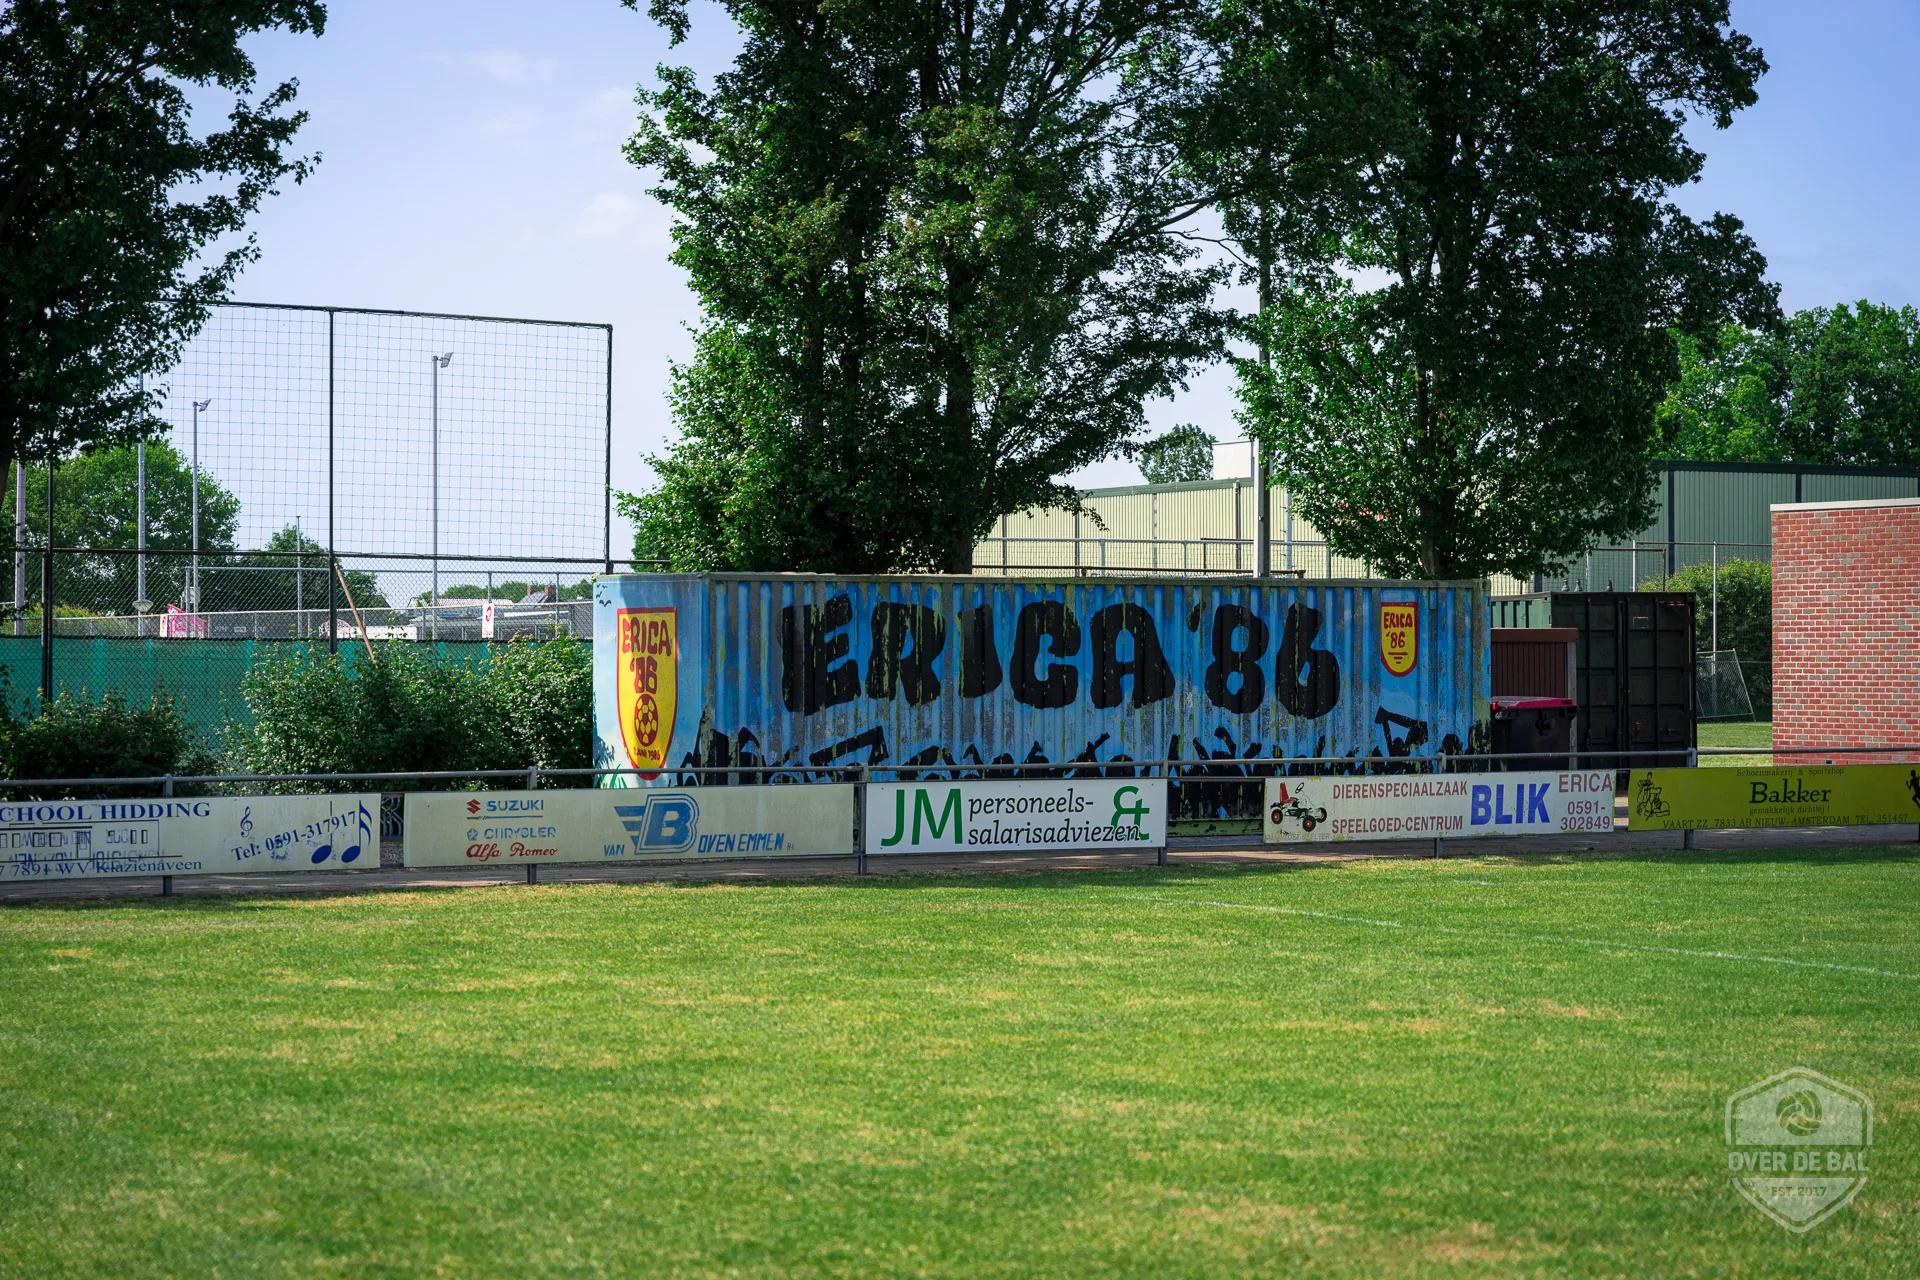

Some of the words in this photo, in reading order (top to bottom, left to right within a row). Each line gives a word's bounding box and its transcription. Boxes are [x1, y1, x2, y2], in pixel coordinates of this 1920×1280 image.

[1383, 611, 1413, 629] ERICA
[622, 616, 672, 656] ERICA
[781, 595, 1175, 715] ERICA
[1736, 769, 1793, 777] Schoenmakerij
[1808, 767, 1845, 776] Sportshop
[1332, 780, 1468, 800] DIERENSPECIAALZAAK
[1558, 773, 1613, 793] ERICA
[1749, 779, 1832, 804] Bakker
[100, 802, 212, 820] HIDDING
[486, 799, 545, 812] SUZUKI
[968, 787, 1094, 823] personeels-
[1470, 782, 1551, 827] BLIK
[1567, 800, 1606, 815] 0591-
[1749, 807, 1795, 816] gemakkelijk
[880, 788, 963, 847] JM
[1331, 815, 1464, 835] SPEELGOED-CENTRUM
[1560, 816, 1611, 831] 302849
[1663, 819, 1694, 829] VAART
[1714, 818, 1737, 828] 7833
[1791, 815, 1850, 826] AMSTERDAM
[1876, 813, 1909, 823] 351457
[231, 843, 262, 862] Tel:
[264, 810, 357, 852] 0591-317917
[483, 826, 556, 840] CHRYSLER
[968, 818, 1141, 846] salarisadviezen
[465, 842, 502, 862] Alfa
[509, 841, 559, 857] Romeo
[603, 844, 625, 857] VAN
[736, 832, 785, 853] EMMEN
[59, 861, 89, 875] WV
